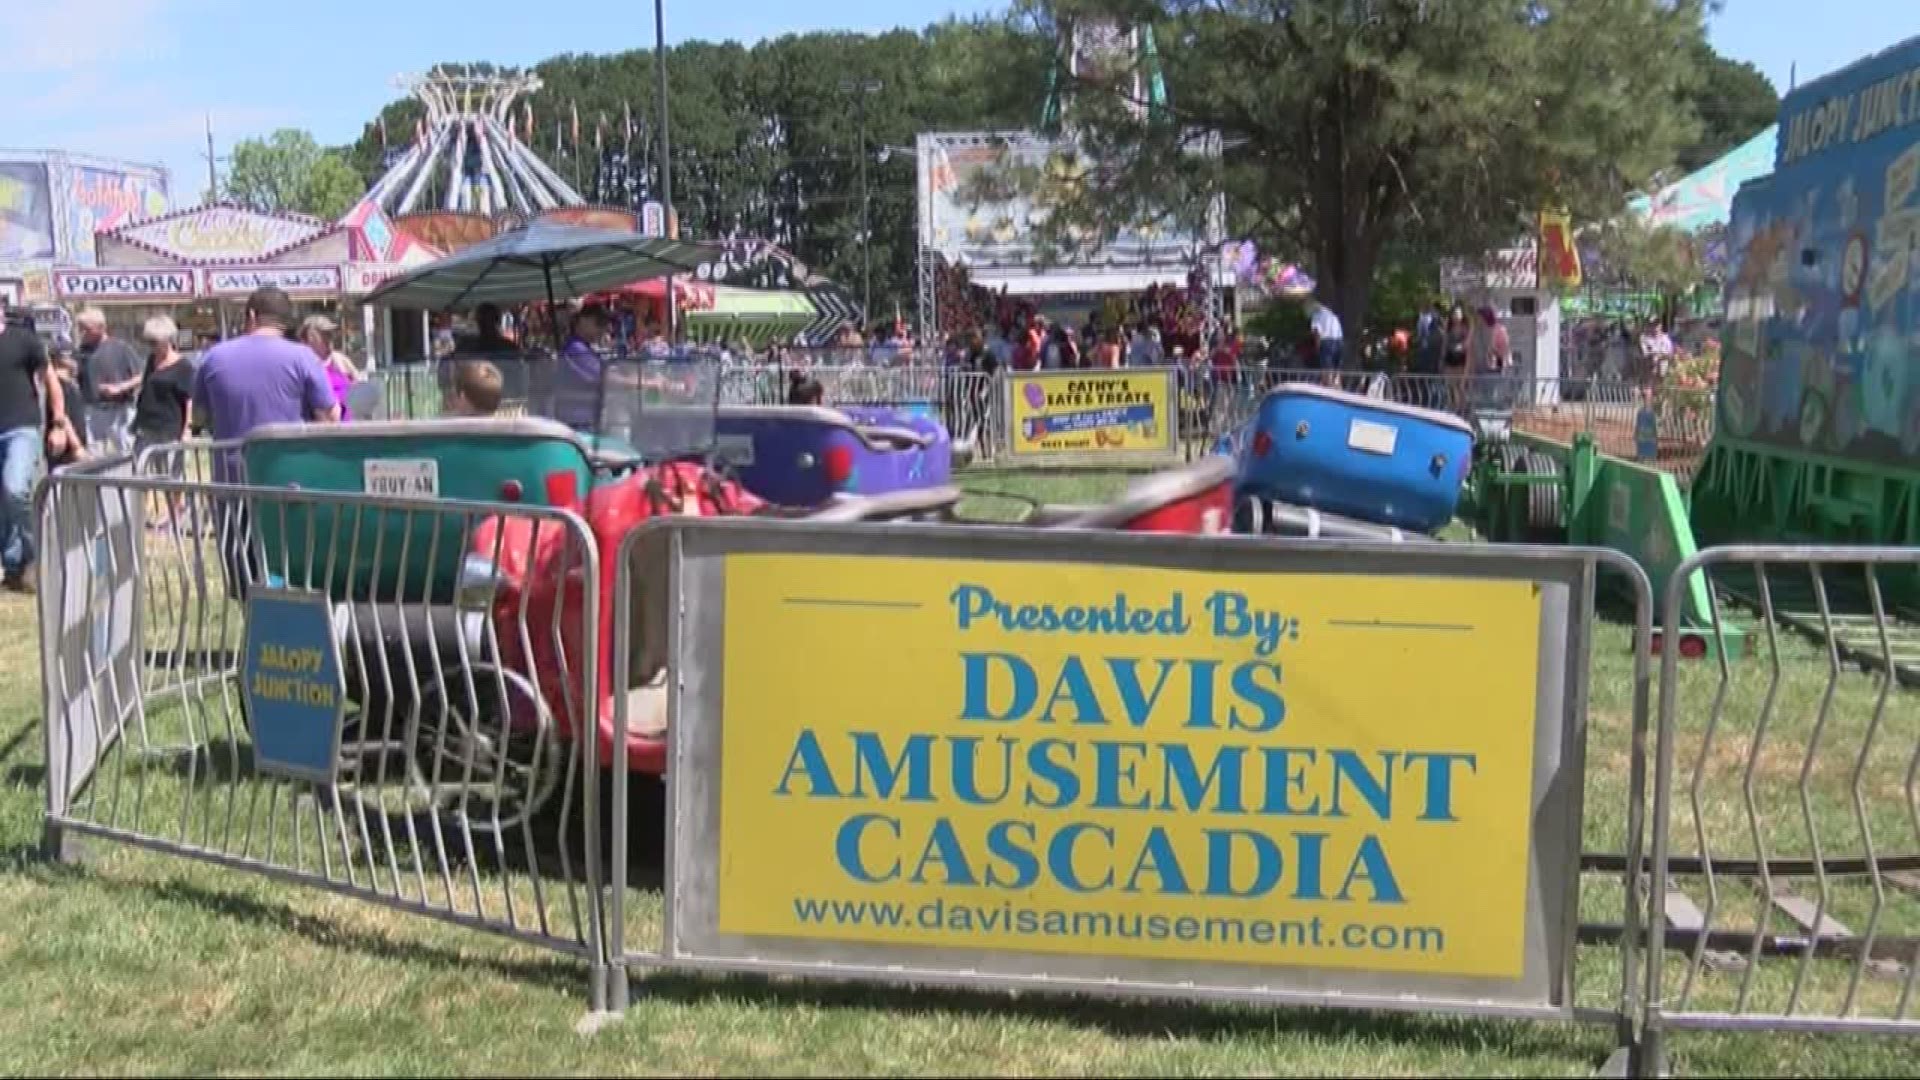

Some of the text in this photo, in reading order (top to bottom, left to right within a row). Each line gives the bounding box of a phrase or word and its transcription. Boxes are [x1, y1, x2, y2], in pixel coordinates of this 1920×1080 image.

[1784, 93, 1855, 163] JALOPY
[66, 275, 183, 293] POPCORN
[1097, 390, 1151, 404] TREATS
[950, 584, 1300, 659] Presented By:
[252, 671, 335, 707] JUNCTION
[261, 643, 323, 672] JALOPY
[958, 651, 1287, 733] DAVIS
[773, 728, 1478, 823] AMUSEMENT
[834, 813, 1407, 905] CASCADIA
[794, 896, 1445, 952] www.davisamusement.com
